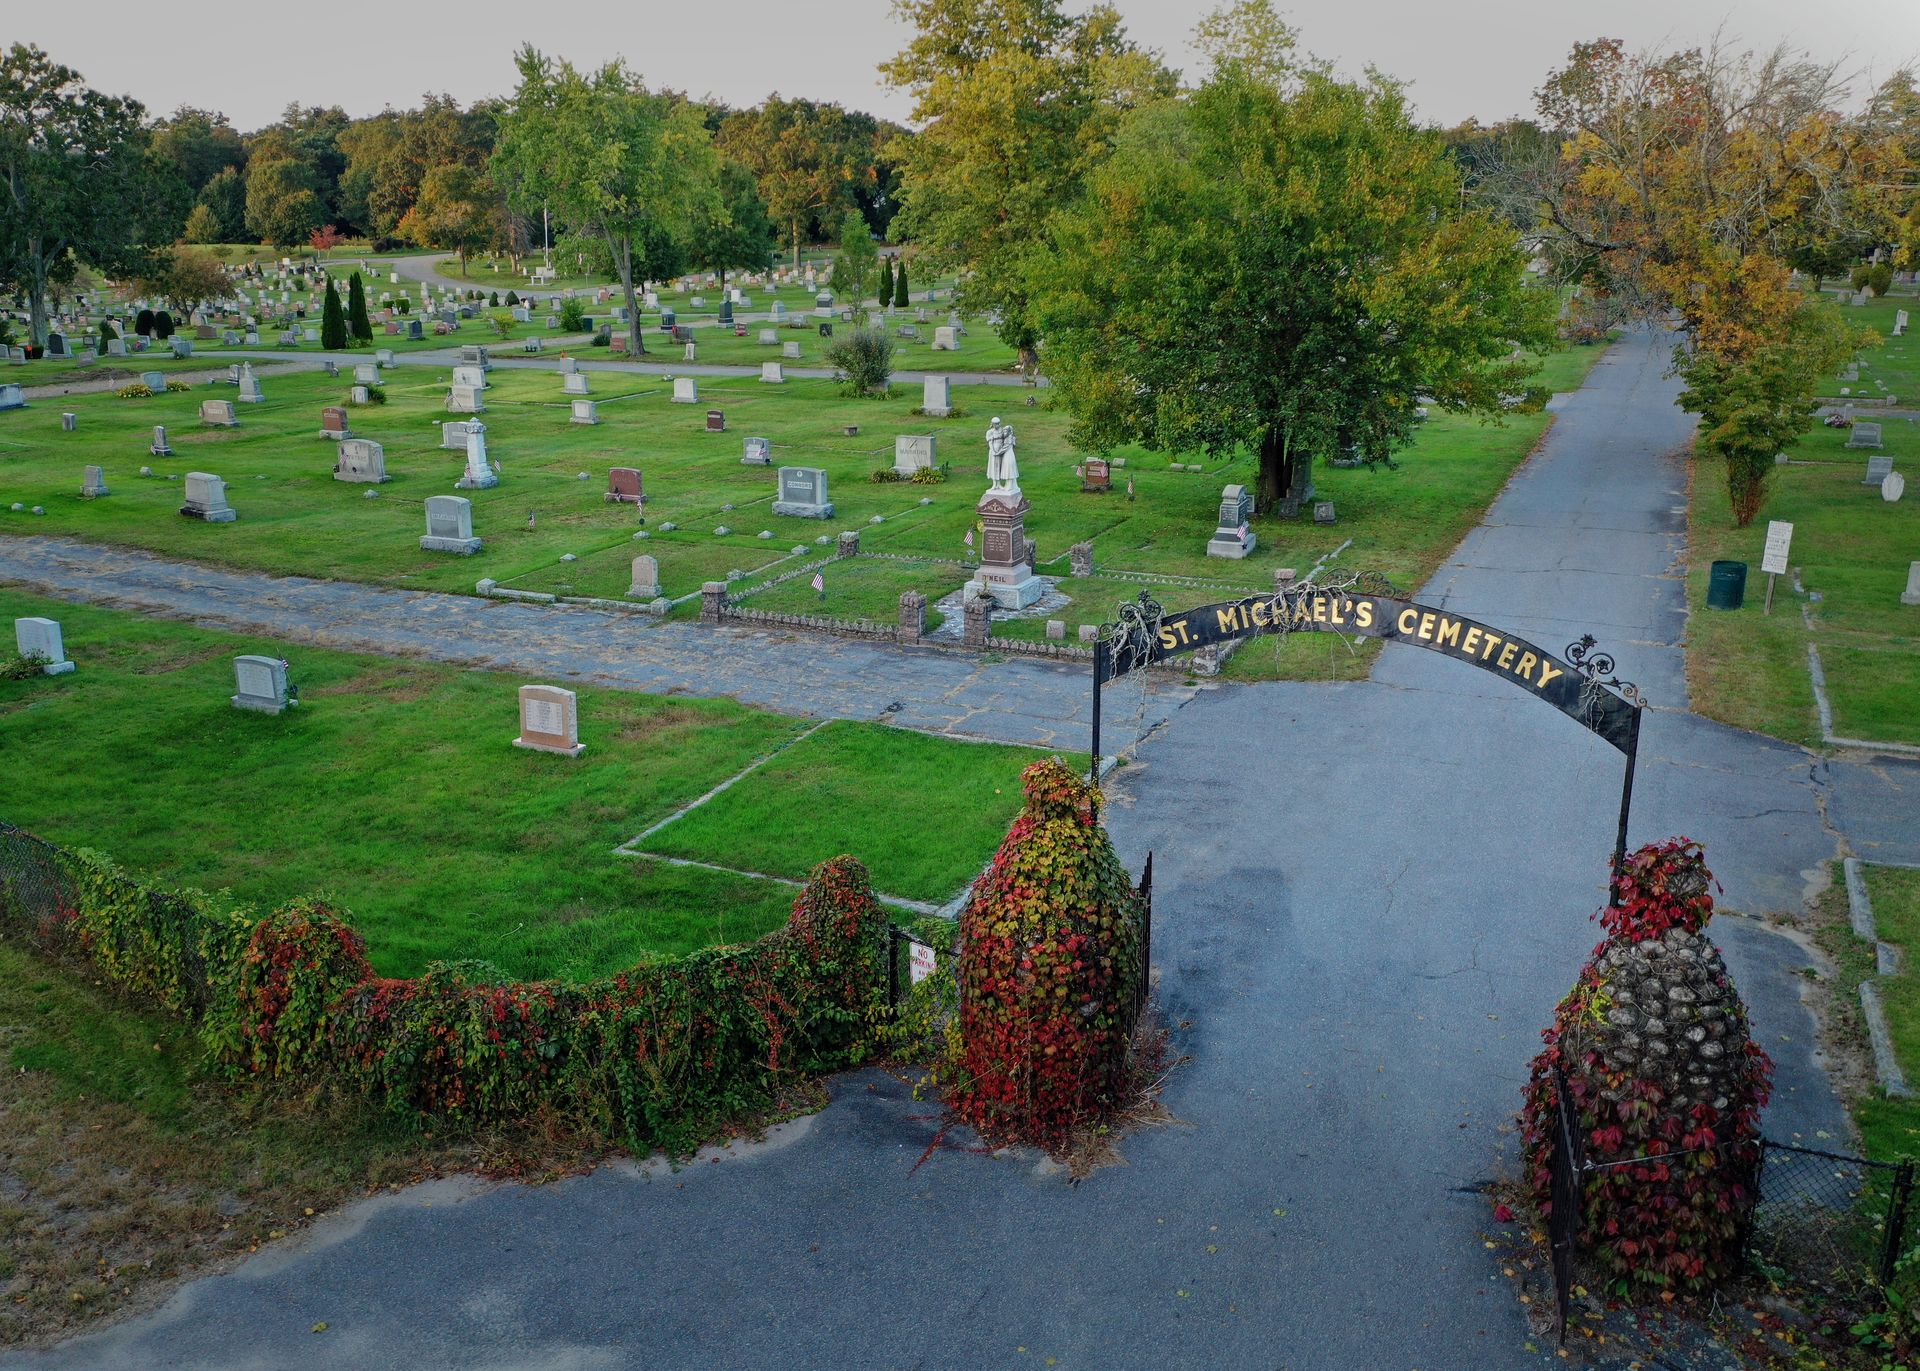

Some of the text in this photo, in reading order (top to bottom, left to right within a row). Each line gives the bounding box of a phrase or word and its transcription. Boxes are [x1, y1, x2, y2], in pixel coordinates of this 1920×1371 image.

[1158, 597, 1564, 689] ST. MICHAEL'S CEMETERY
[918, 948, 928, 959] NO
